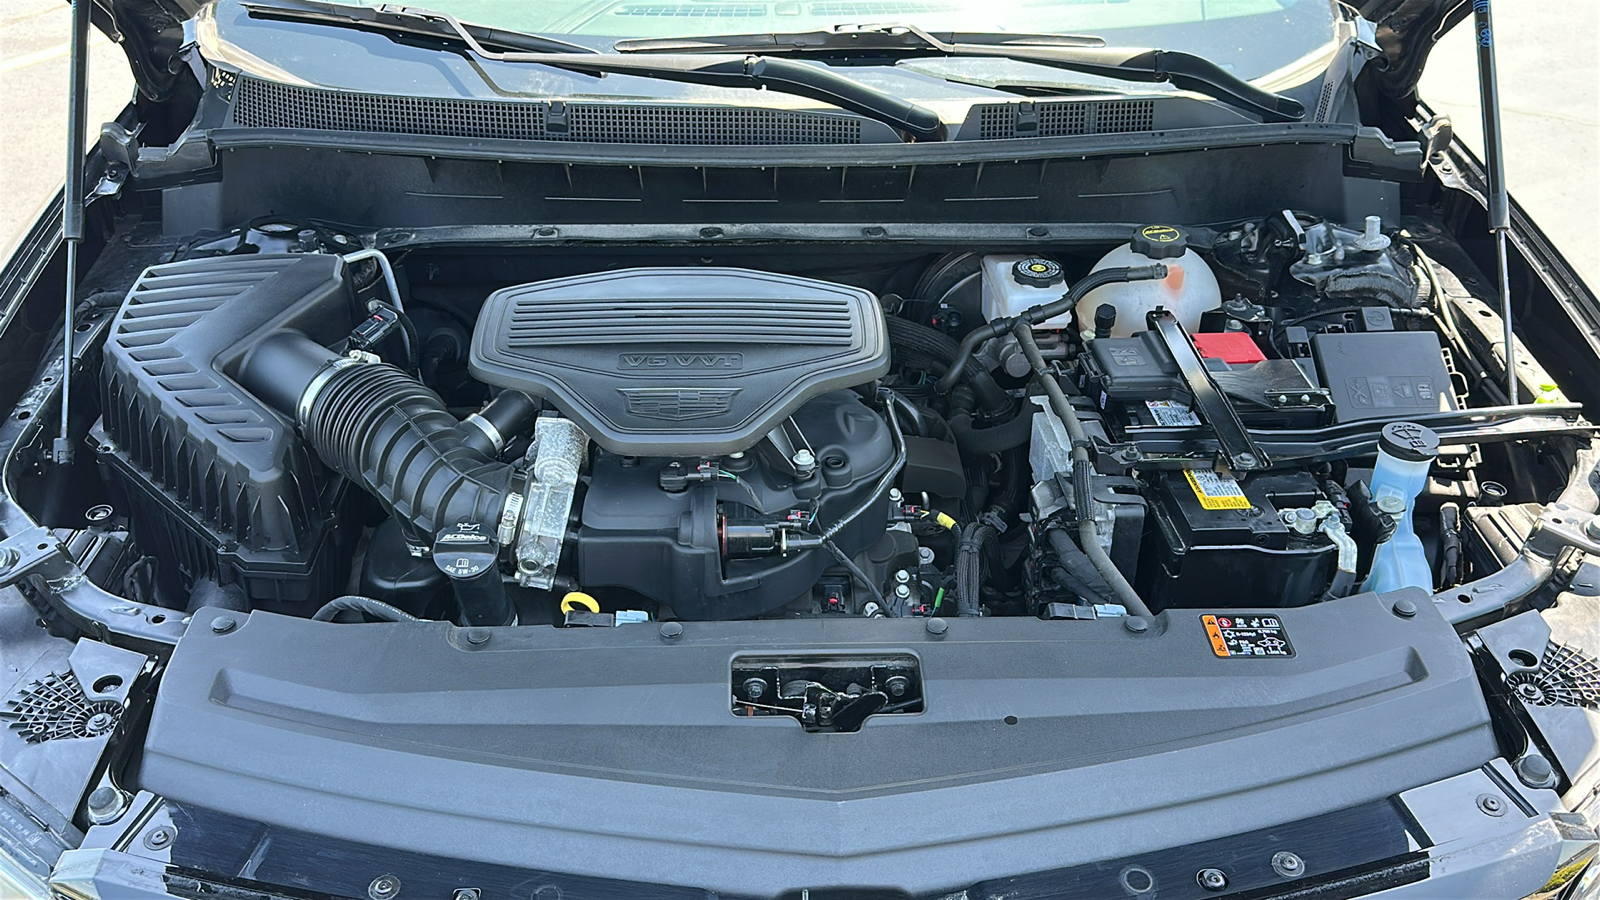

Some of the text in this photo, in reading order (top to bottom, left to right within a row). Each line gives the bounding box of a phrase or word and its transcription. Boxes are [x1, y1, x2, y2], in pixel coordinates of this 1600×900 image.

[624, 355, 738, 366] V6 VVT
[444, 565, 479, 574] SAE 5W-30
